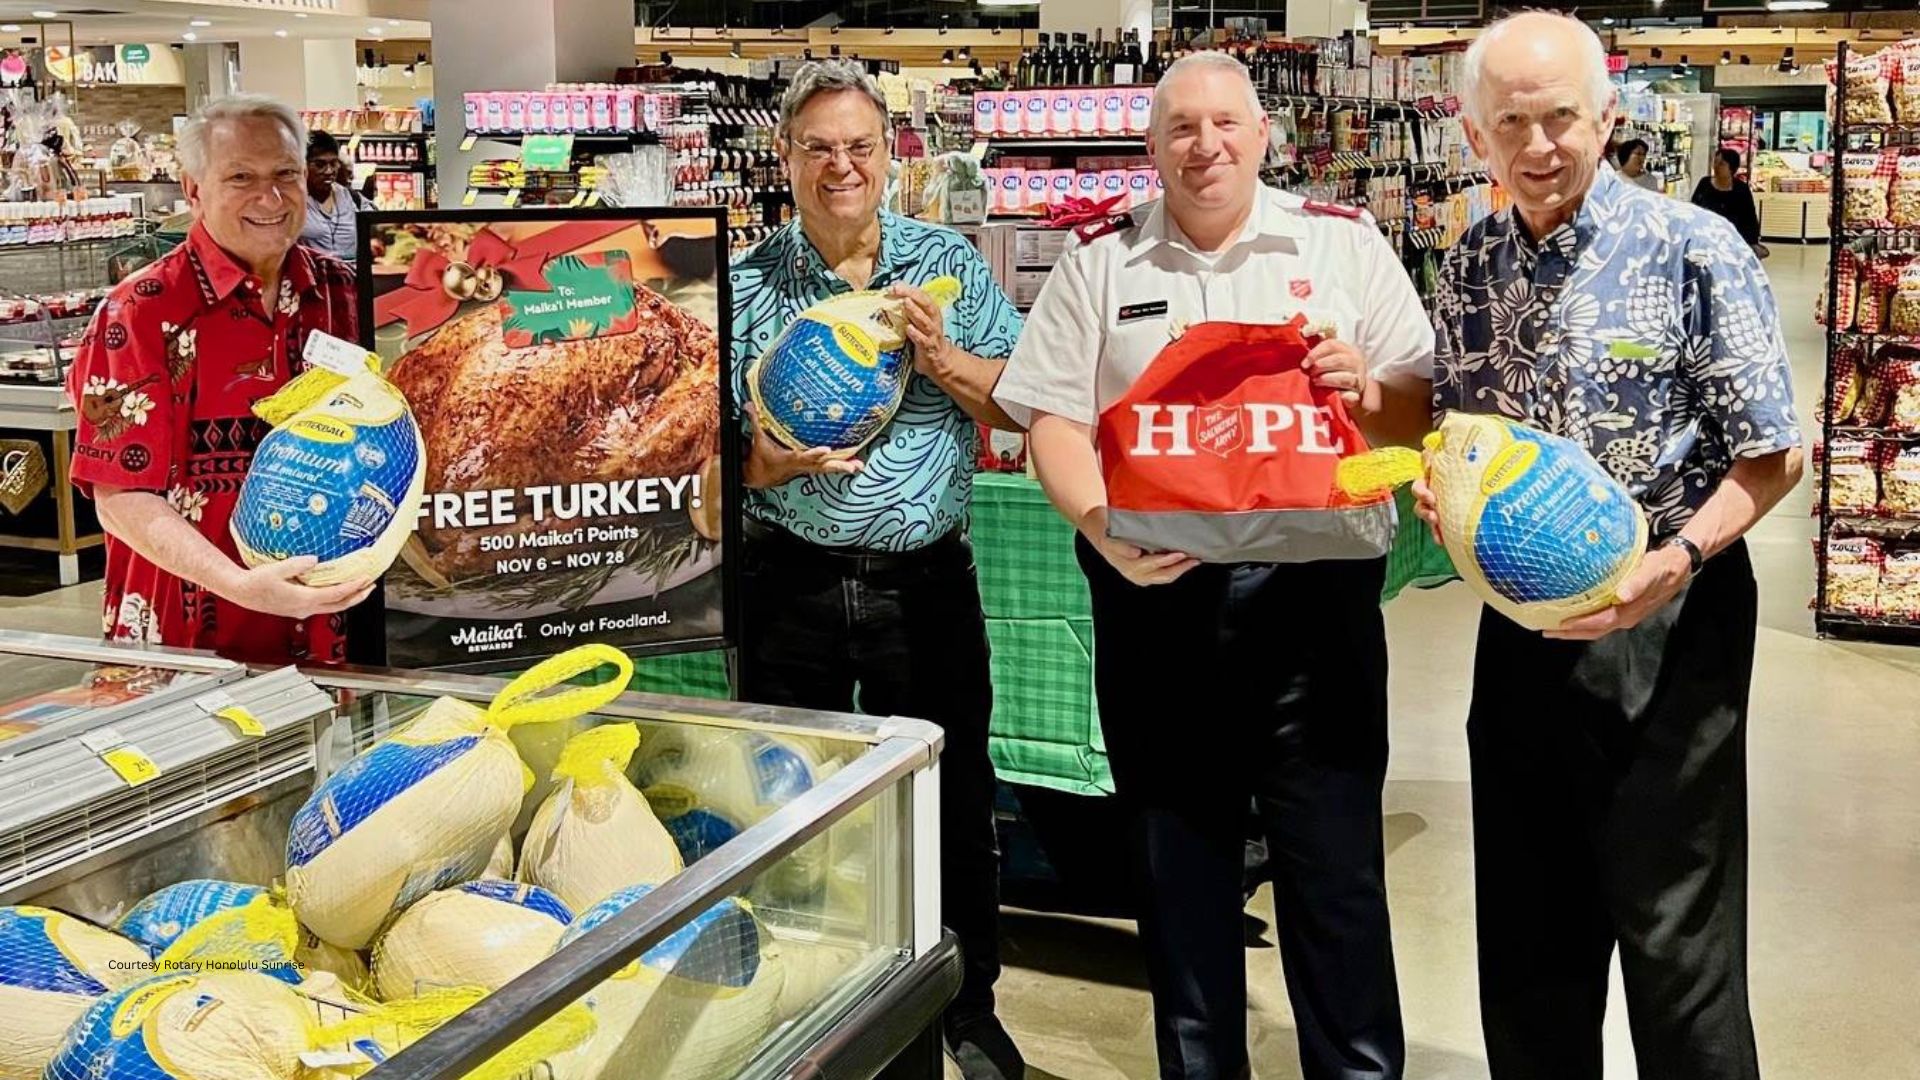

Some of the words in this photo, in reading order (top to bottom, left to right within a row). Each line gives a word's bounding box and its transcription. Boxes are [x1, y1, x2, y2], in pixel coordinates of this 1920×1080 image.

[558, 285, 576, 297] To:
[566, 295, 612, 310] Member
[805, 335, 865, 394] Premium
[1199, 411, 1238, 444] SALVATION
[1205, 410, 1222, 428] THE
[1213, 424, 1238, 450] ARMY
[75, 443, 116, 463] otary
[263, 442, 345, 475] Premium
[412, 488, 517, 531] FREE
[523, 474, 702, 521] TURKEY!
[1502, 457, 1570, 526] Premium
[480, 534, 515, 552] 500
[587, 525, 639, 543] Points
[496, 557, 532, 575] NOV
[536, 558, 548, 571] 6
[567, 552, 601, 568] NOV
[605, 550, 625, 565] 28
[540, 620, 575, 638] Only
[579, 620, 595, 633] at
[598, 611, 671, 631] Foodland.
[468, 641, 513, 653] REWARDS
